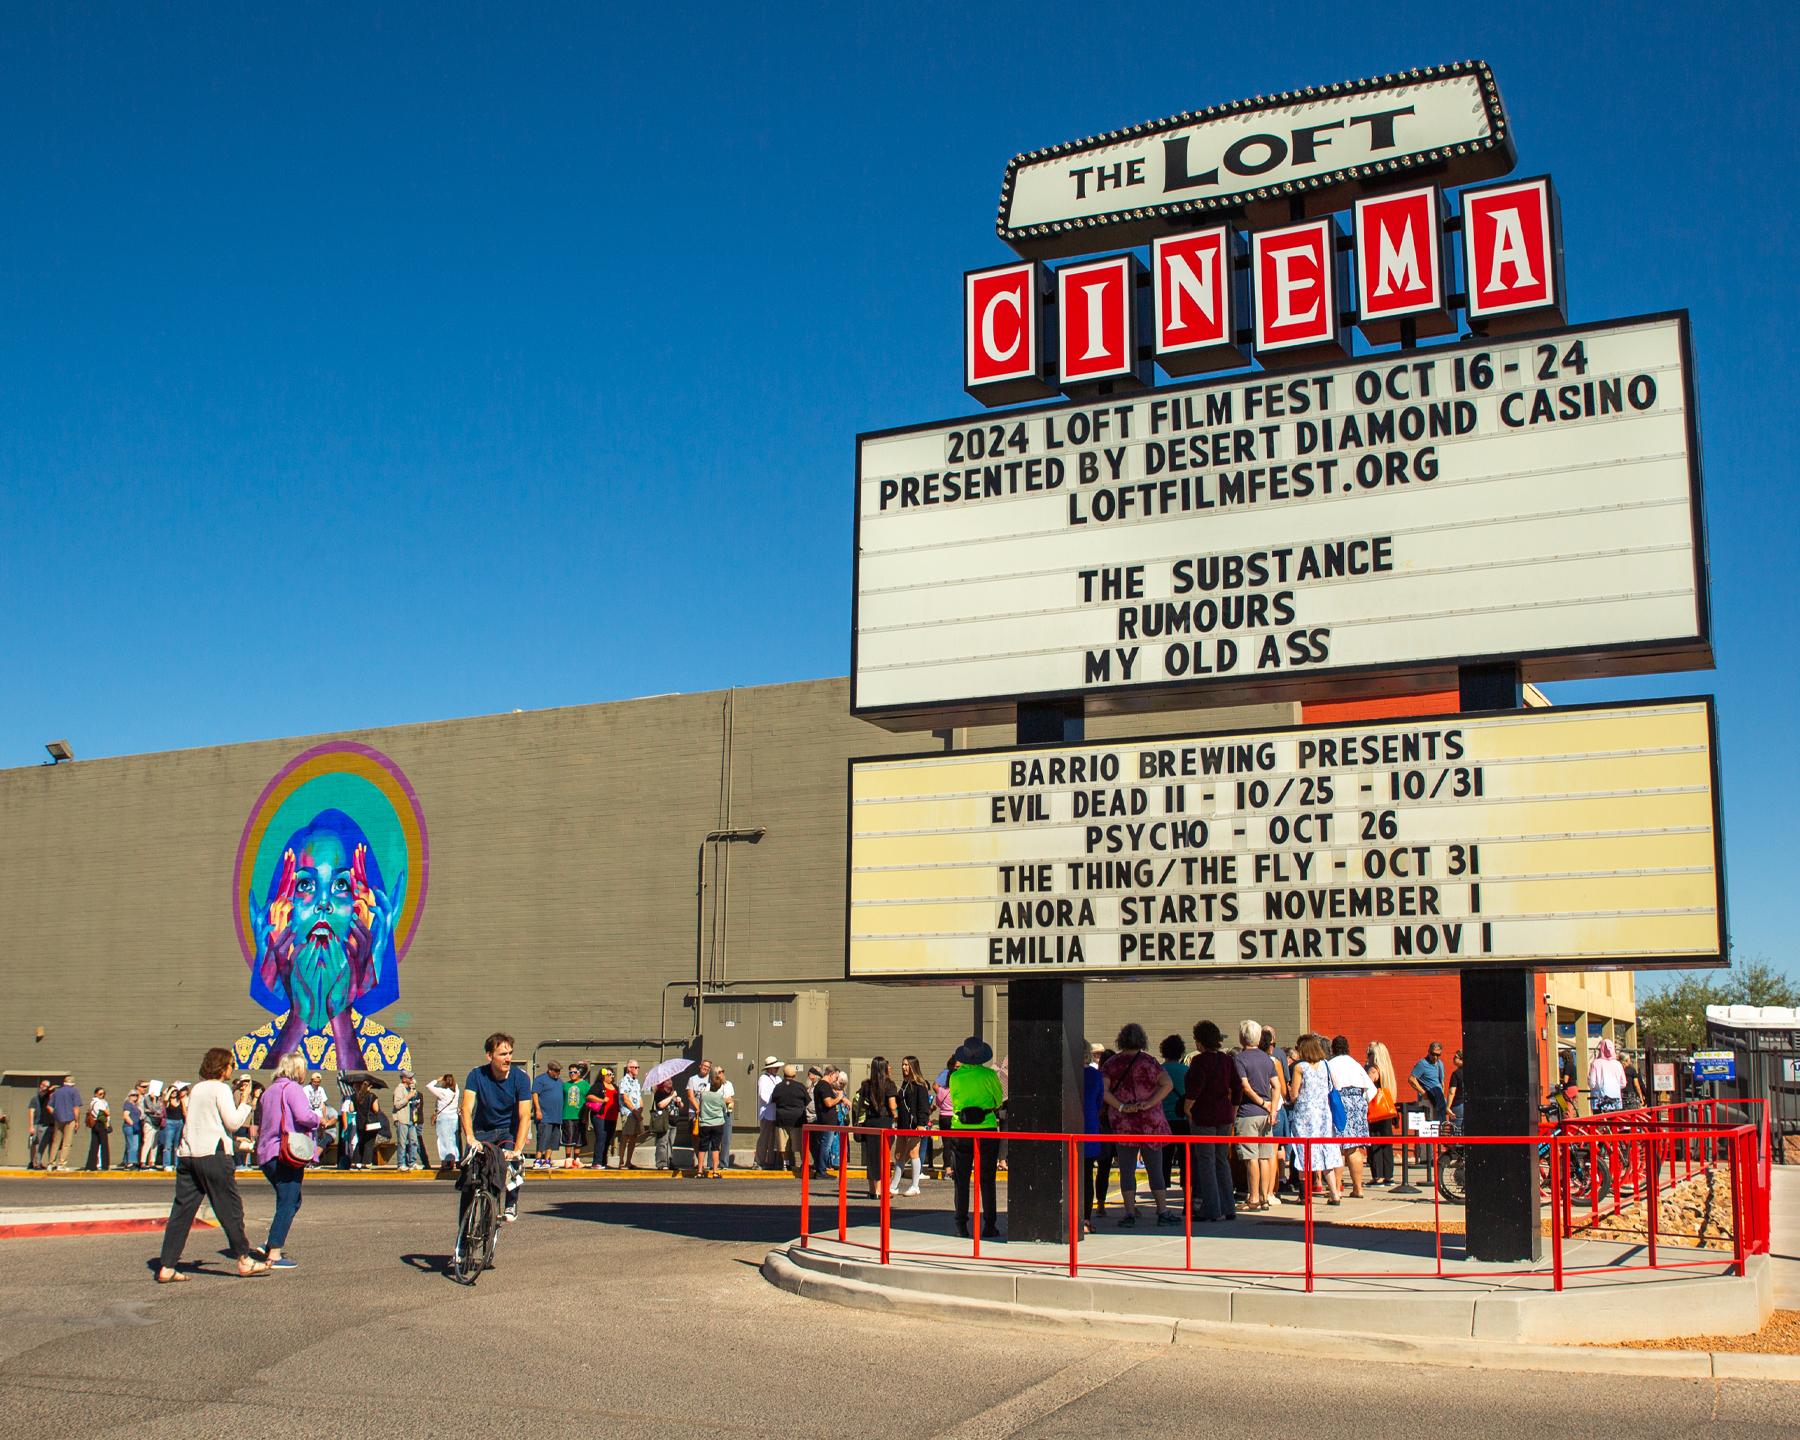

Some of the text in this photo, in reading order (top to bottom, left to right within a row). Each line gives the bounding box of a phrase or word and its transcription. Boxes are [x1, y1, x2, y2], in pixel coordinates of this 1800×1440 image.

[1069, 105, 1415, 199] THE LOFT
[982, 207, 1541, 361] CINEMA
[948, 422, 1029, 464] 2024
[1046, 405, 1133, 449] LOFT
[1151, 392, 1232, 434] FILM
[1245, 376, 1333, 420] FEST
[1356, 361, 1435, 405] OCT
[1454, 353, 1493, 392] 16
[1538, 340, 1588, 380] 24
[880, 375, 1656, 510] PRESENTED BY DESERT DIAMOND CASINO
[1070, 446, 1438, 525] LOFTFILMFEST.ORG
[1079, 536, 1392, 602] THE SUBSTANCE
[1119, 591, 1295, 640] RUMOURS
[1086, 628, 1330, 683] MY OLD ASS
[1011, 730, 1463, 786] BARRIO BREWING PRESENTS
[992, 794, 1049, 823] EVIL
[1074, 788, 1147, 818] DEAD
[1166, 785, 1184, 813] II
[1237, 776, 1333, 809] 10/25
[1391, 768, 1482, 800] 10/31
[1087, 820, 1208, 853] PSYCHO
[1269, 813, 1333, 844] OCT
[1361, 810, 1397, 840] 26
[999, 865, 1052, 893] THE
[1068, 856, 1236, 890] THING/THE
[1255, 852, 1314, 883] FLY
[1364, 847, 1430, 879] OCT
[1449, 845, 1479, 875] 31
[998, 898, 1095, 929] ANORA
[1121, 892, 1238, 925] STARTS
[1266, 886, 1440, 920] NOVEMBER
[989, 935, 1084, 964] EMILIA
[1120, 932, 1214, 961] PEREZ
[1240, 926, 1366, 959] STARTS
[1394, 924, 1462, 955] NOV
